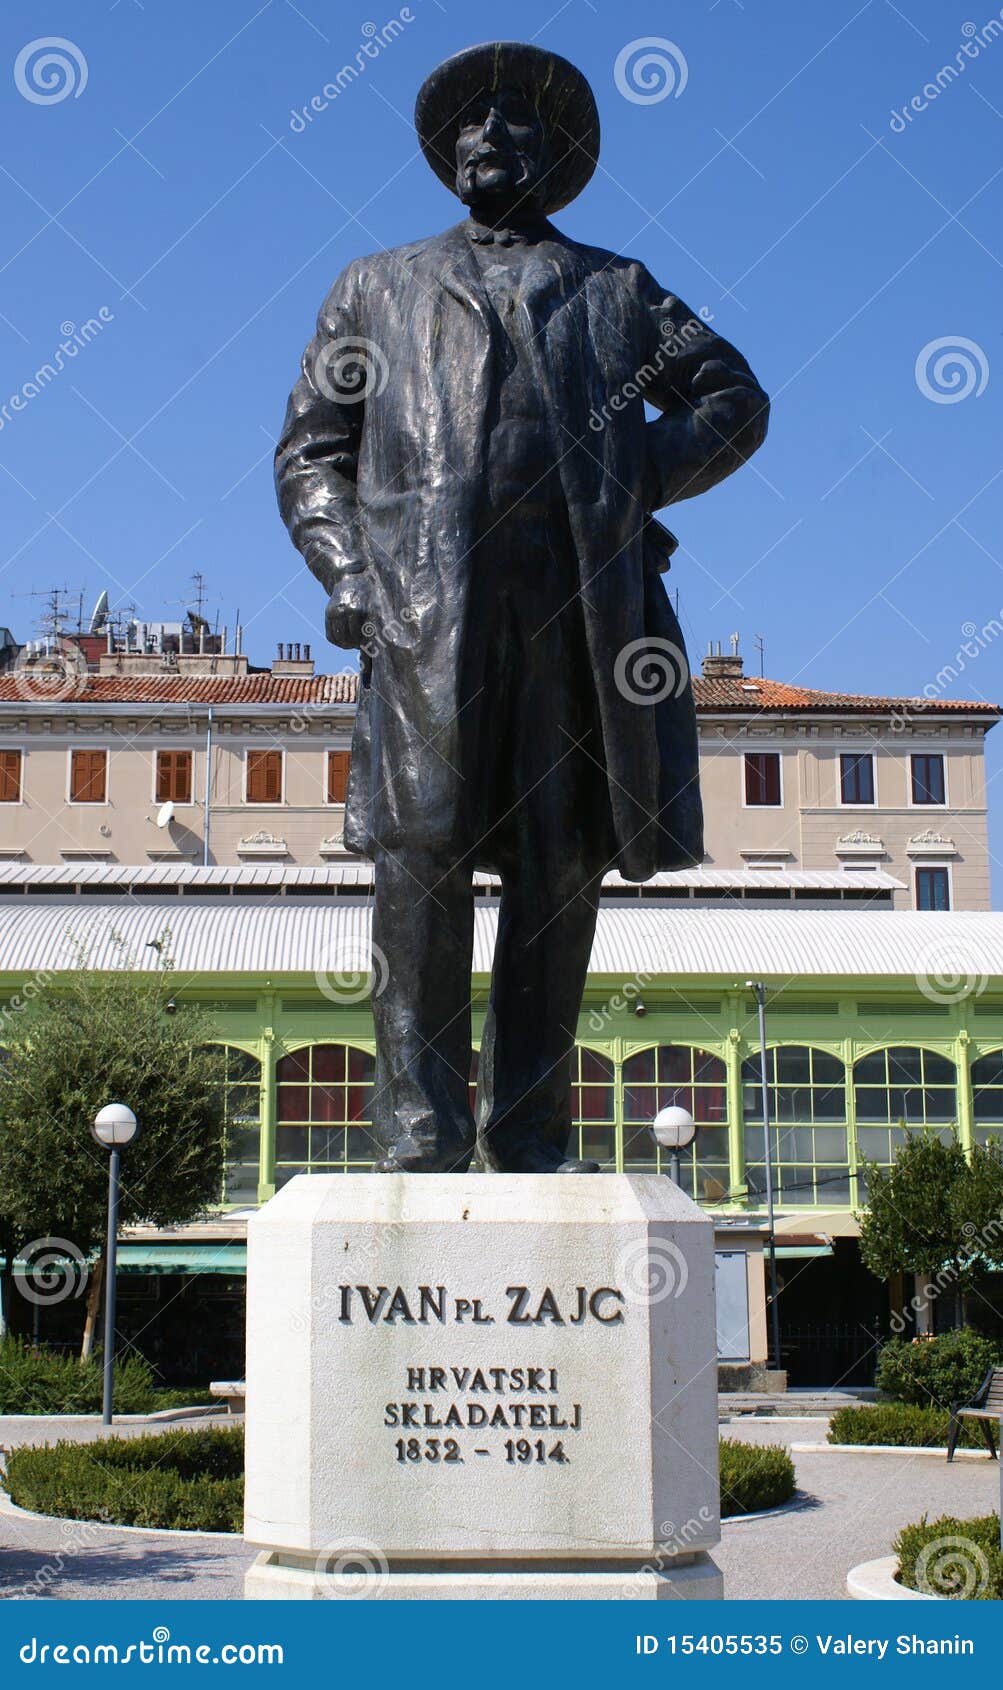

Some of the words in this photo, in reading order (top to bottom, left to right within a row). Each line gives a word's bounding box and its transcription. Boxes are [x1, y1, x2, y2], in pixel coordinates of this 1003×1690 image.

[338, 1285, 447, 1324] IVAN
[505, 1286, 626, 1325] ZAJC
[405, 1367, 560, 1393] HRVATSKI
[383, 1403, 584, 1429] SKLADATELJ
[474, 1448, 490, 1456] -
